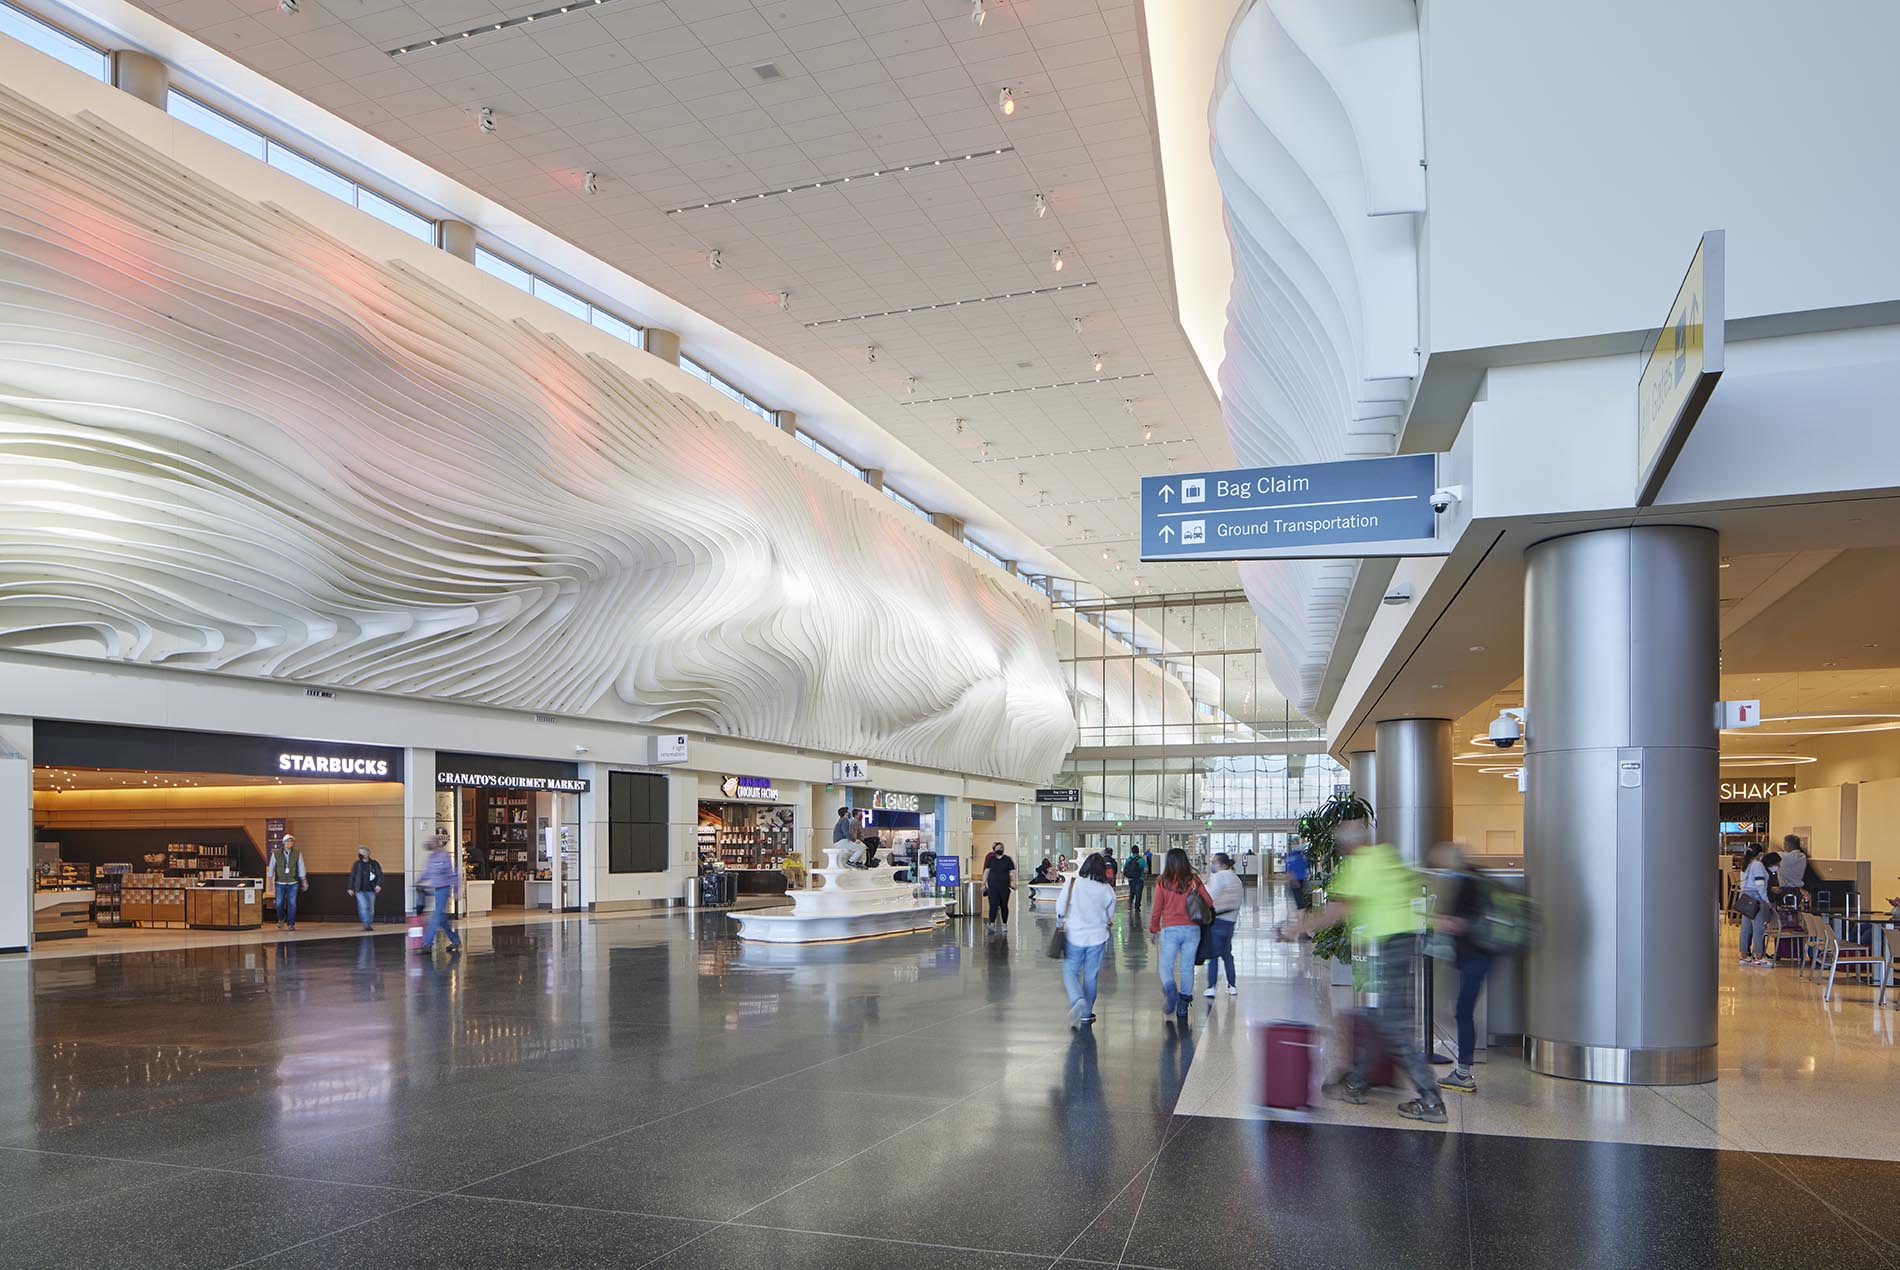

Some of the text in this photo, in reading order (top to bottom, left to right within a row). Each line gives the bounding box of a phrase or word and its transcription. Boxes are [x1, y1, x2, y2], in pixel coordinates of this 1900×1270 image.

[1217, 475, 1309, 498] Bag Claim
[1217, 514, 1378, 536] Ground Transportation
[279, 754, 388, 775] STARBUCKS
[437, 772, 586, 790] GRANATO'S GOURMET MARKET
[1720, 783, 1789, 800] SHAKE
[885, 793, 919, 811] CNBC
